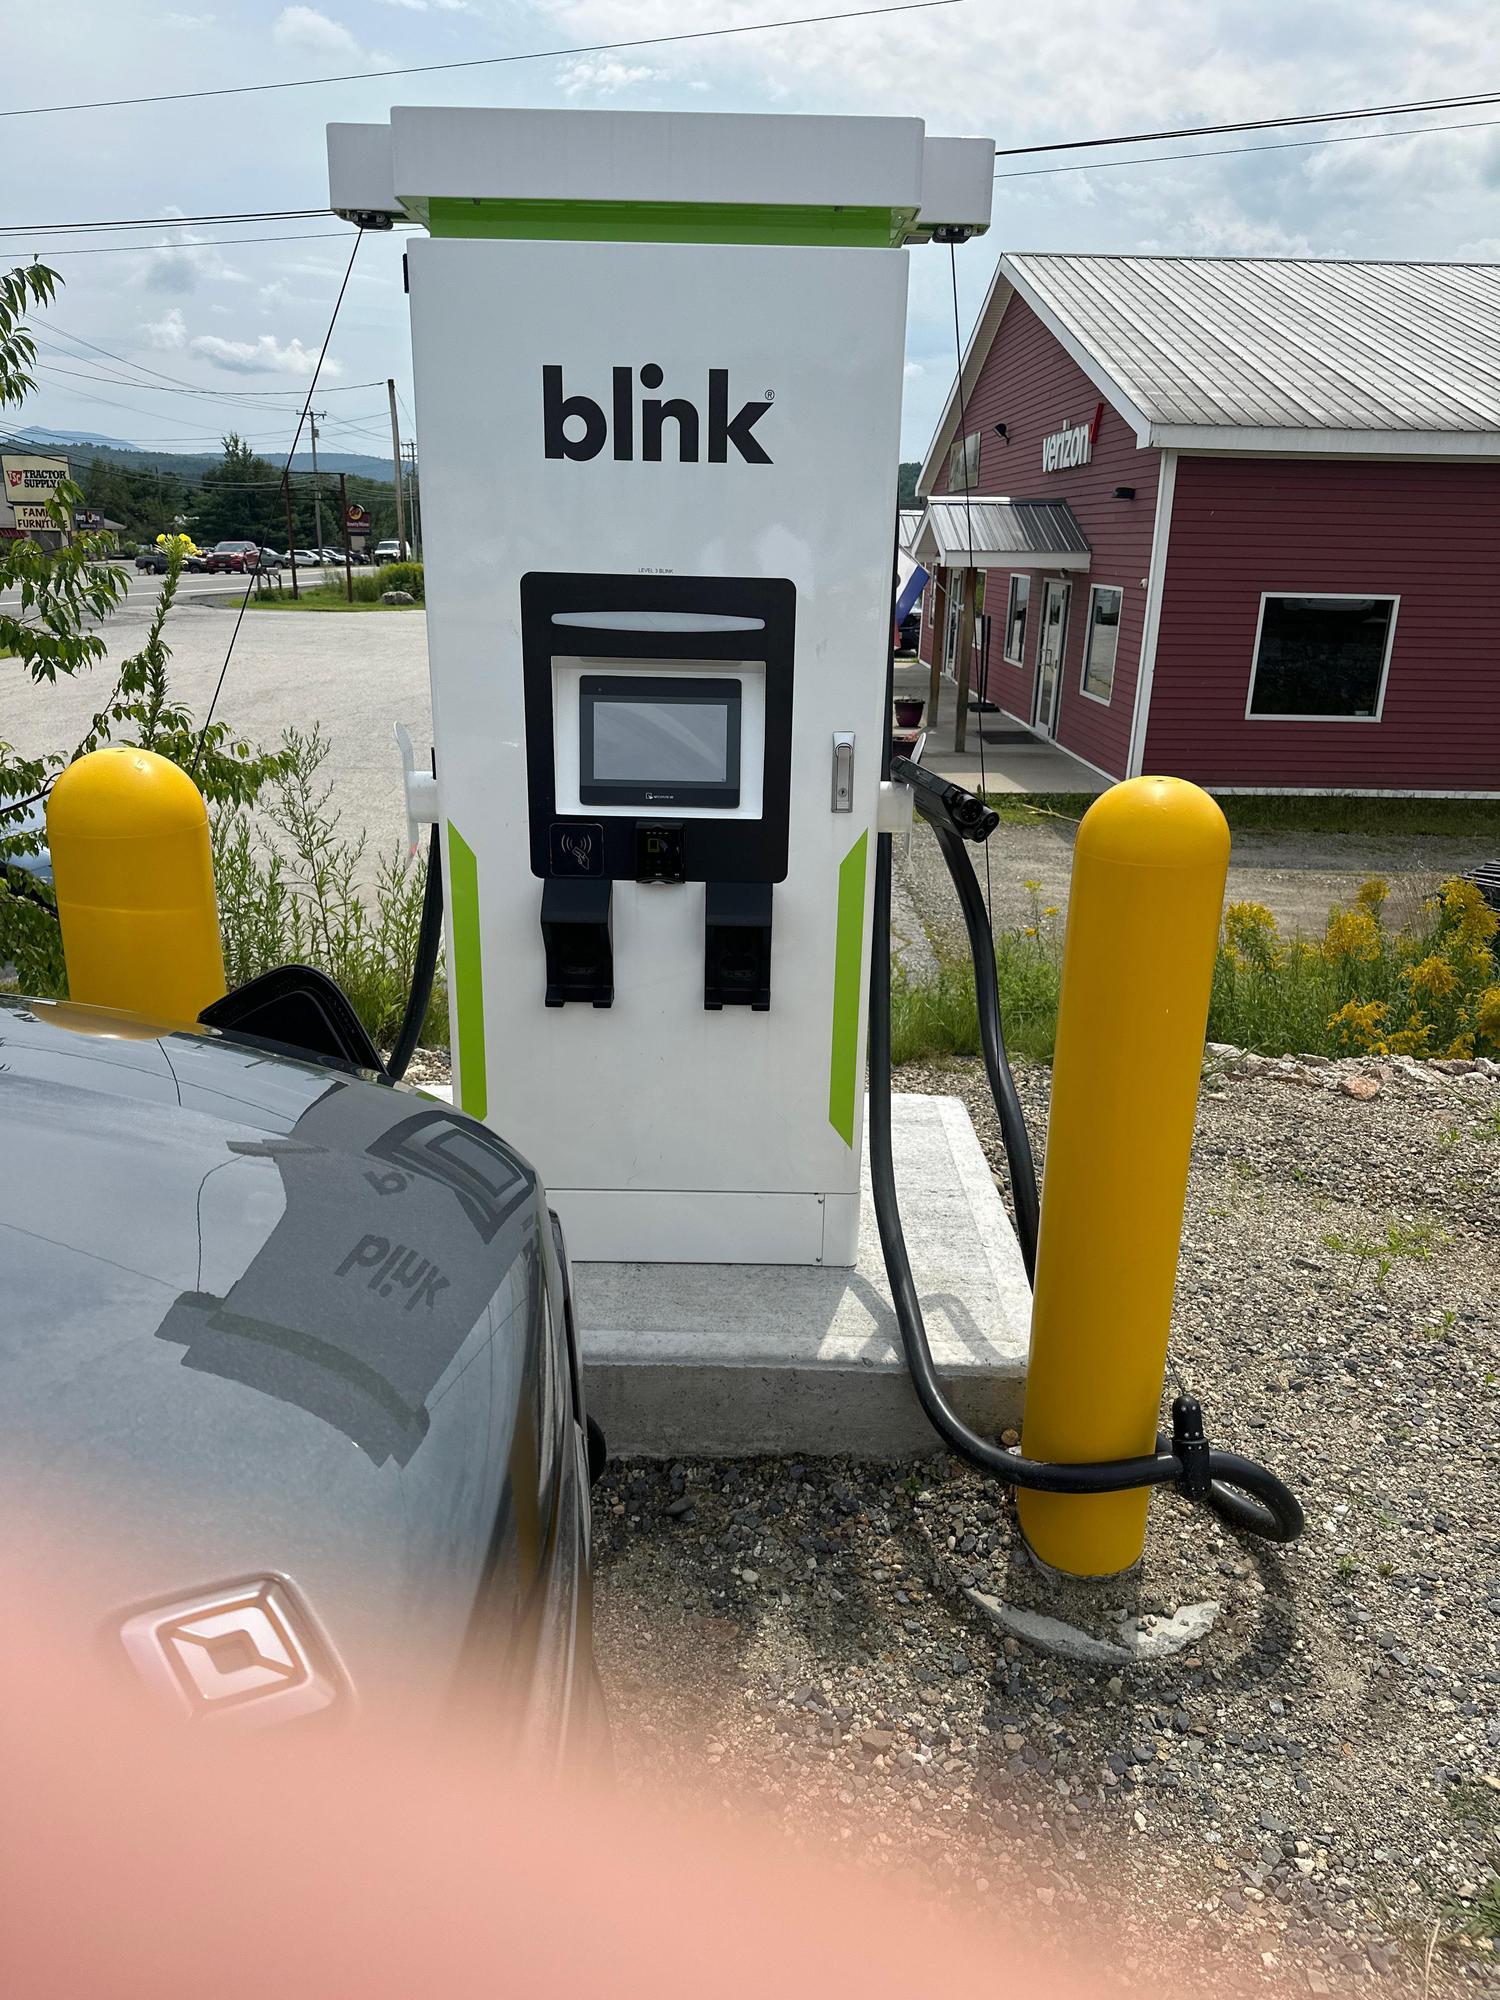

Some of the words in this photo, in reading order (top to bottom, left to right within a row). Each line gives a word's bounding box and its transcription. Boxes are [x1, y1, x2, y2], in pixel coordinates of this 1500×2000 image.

[542, 363, 774, 464] blink
[1042, 420, 1092, 473] verizon
[8, 471, 21, 484] TSC
[23, 470, 67, 479] TRACTOR
[24, 479, 57, 488] SUPPLY
[23, 507, 48, 517] FAMI
[17, 519, 68, 529] FURNITUE
